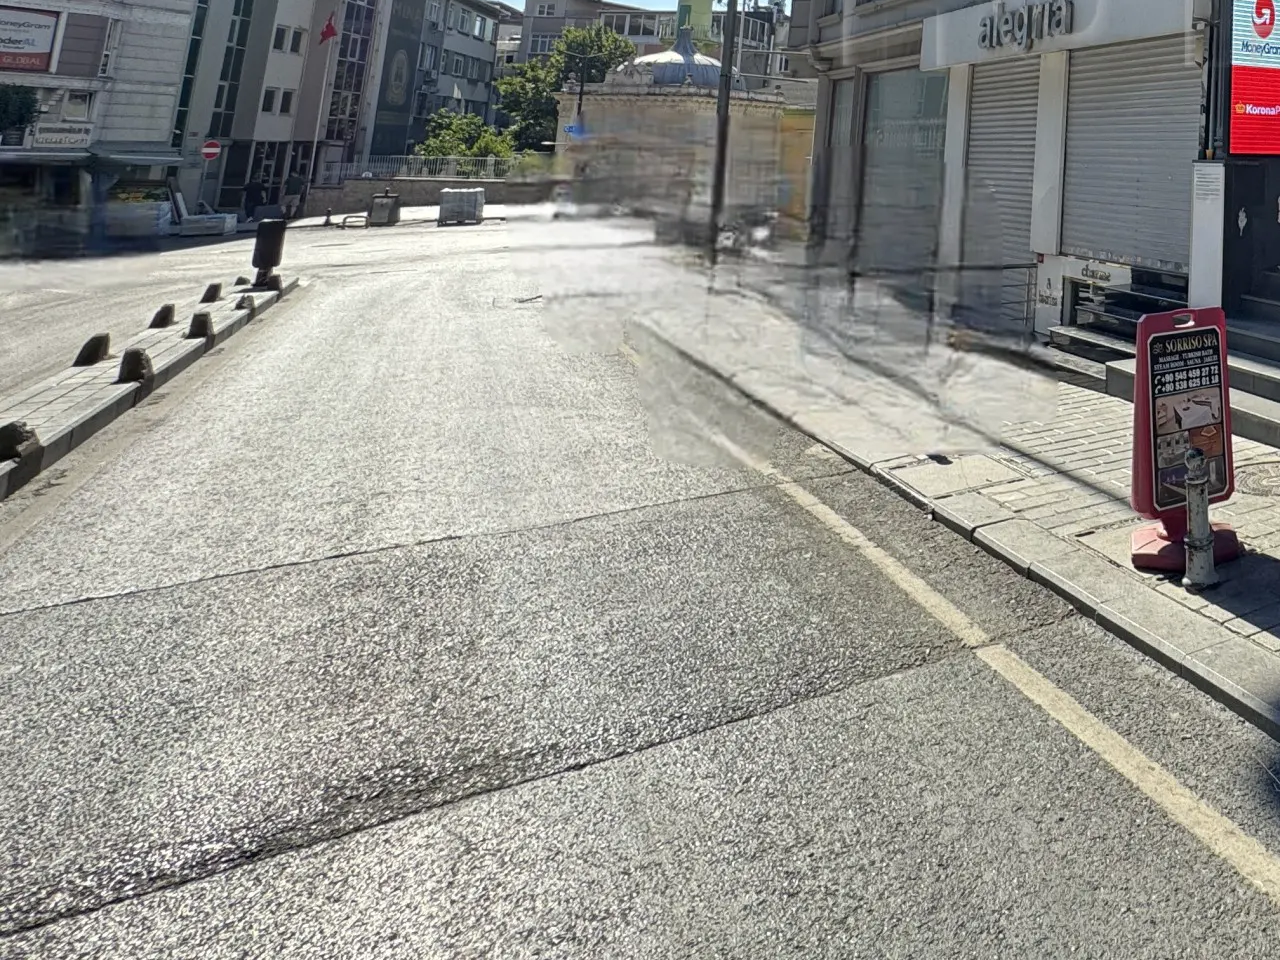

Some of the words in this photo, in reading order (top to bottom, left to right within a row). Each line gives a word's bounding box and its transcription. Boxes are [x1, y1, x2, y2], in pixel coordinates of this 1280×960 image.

[1165, 336, 1202, 353] SORRISO
[1203, 334, 1218, 347] SPA
[1153, 363, 1169, 371] STEAM
[1186, 358, 1201, 366] SAUNA
[1161, 373, 1174, 384] +90
[1175, 370, 1187, 380] 545
[1188, 368, 1201, 378] 459
[1201, 367, 1210, 376] 27
[1210, 365, 1219, 374] 72
[1161, 382, 1174, 392] +90
[1201, 376, 1210, 385] 01
